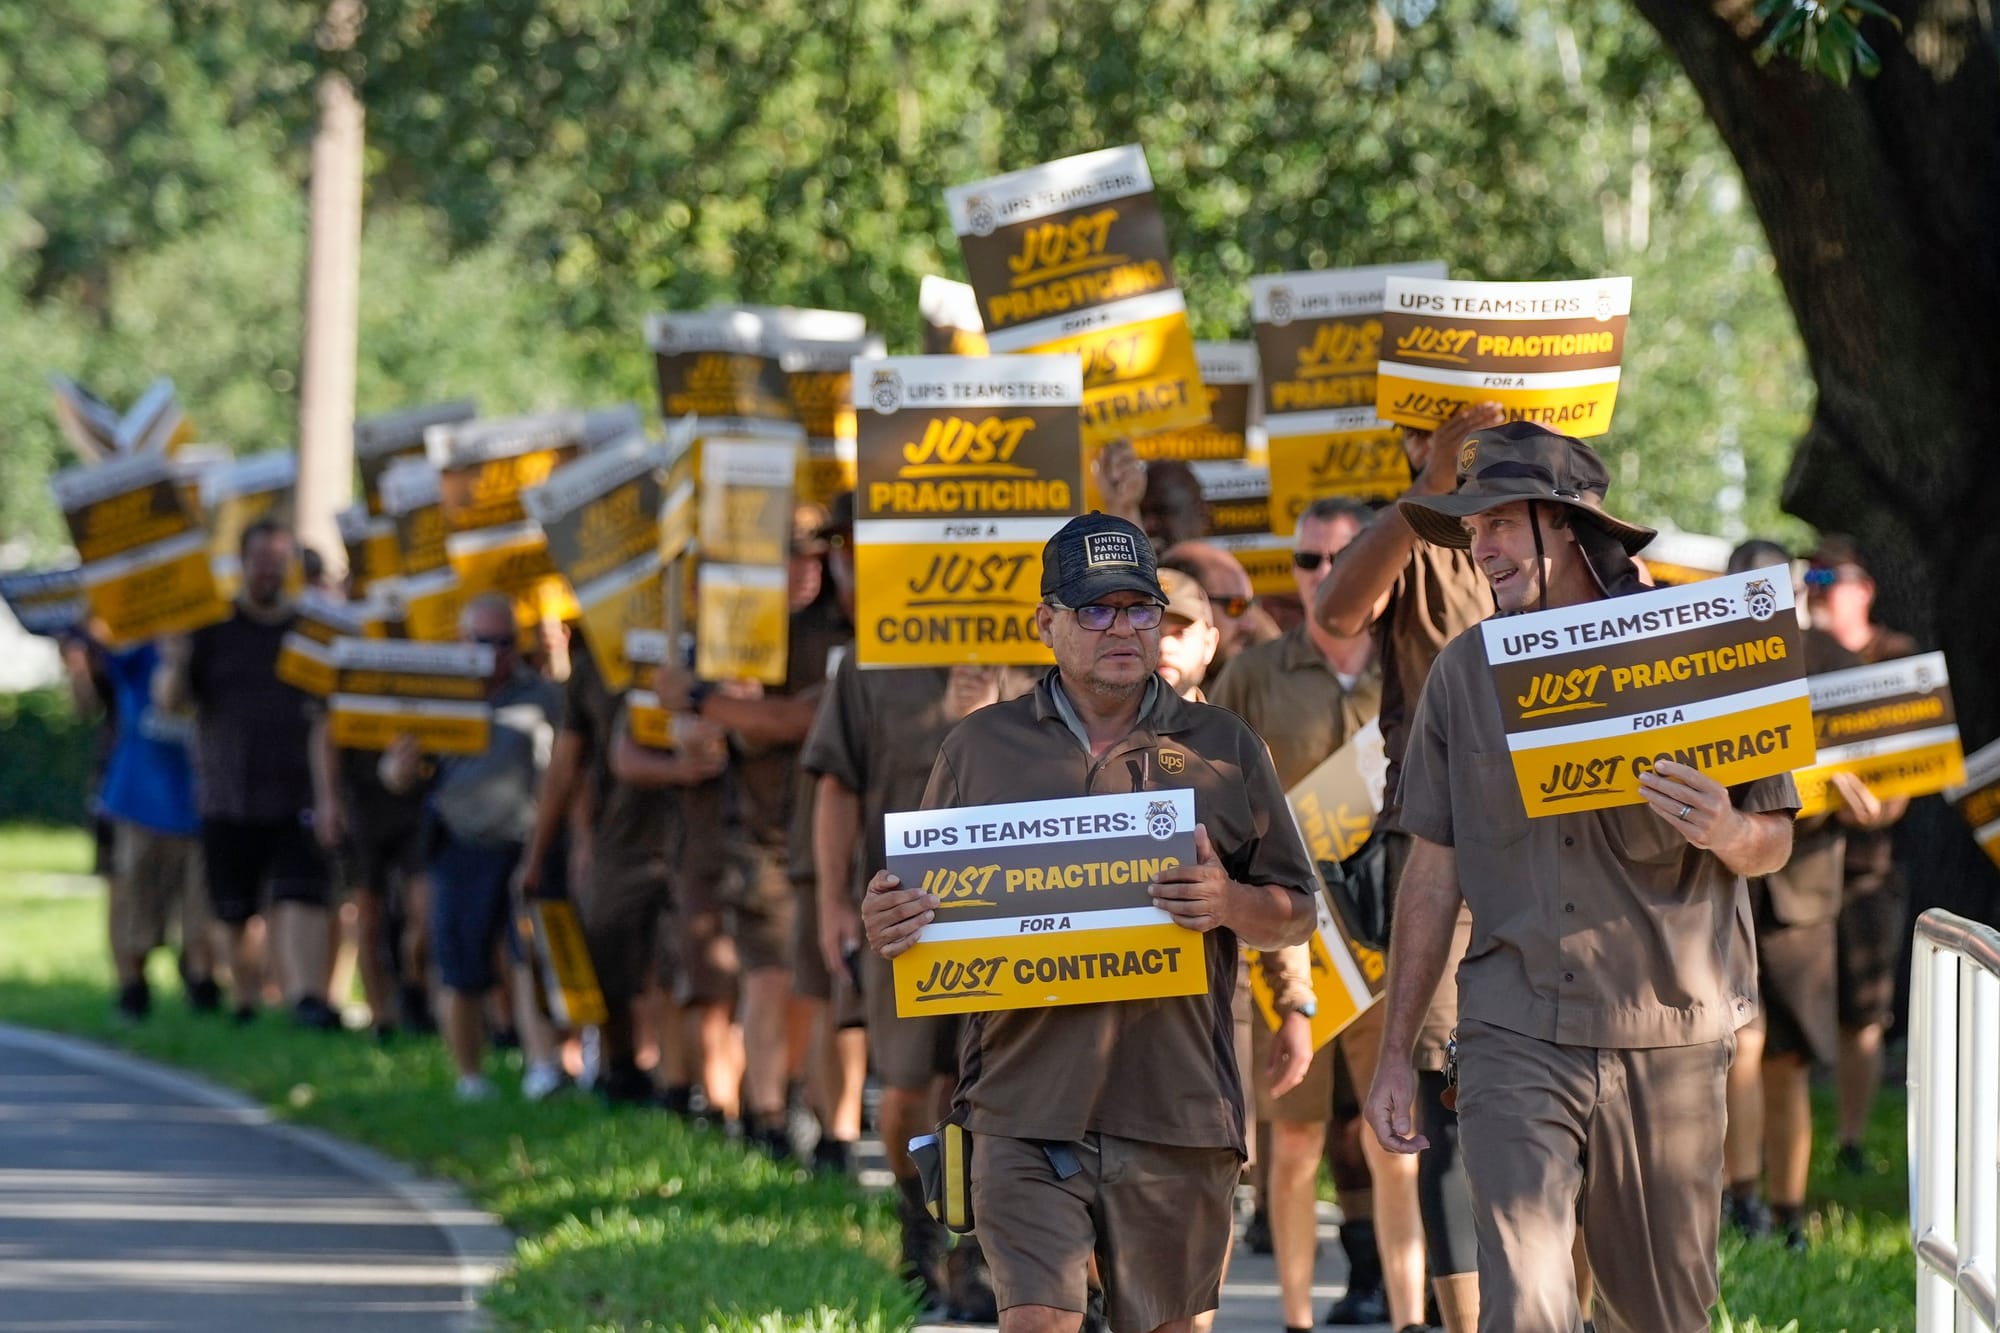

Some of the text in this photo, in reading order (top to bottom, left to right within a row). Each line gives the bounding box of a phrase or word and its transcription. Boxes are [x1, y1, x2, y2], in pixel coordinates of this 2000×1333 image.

[1008, 208, 1119, 275] JUST
[988, 259, 1166, 325] PRACTICING
[1400, 293, 1444, 311] UPS
[1297, 319, 1384, 362] JUS
[1397, 325, 1615, 357] JUST PRACTICING
[1484, 377, 1526, 387] FOR A
[903, 416, 1037, 464] JUST
[869, 479, 1071, 512] PRACTICING
[1094, 536, 1127, 544] UNITED
[1094, 552, 1132, 561] SERVICE
[1095, 544, 1130, 553] PARCEL
[909, 553, 1036, 594] JUST
[877, 616, 1040, 643] CONTRAC
[1503, 597, 1737, 657] UPS TEAMSTERS:
[1517, 664, 1607, 709] JUST
[1611, 635, 1787, 692] PRACTICING
[1632, 709, 1685, 730] FOR A
[1161, 754, 1183, 769] ups
[1540, 755, 1625, 794] JUST
[903, 812, 1137, 849] UPS TEAMSTERS:
[1019, 917, 1072, 933] FOR A
[916, 947, 1182, 993] JUST CONTRACT
